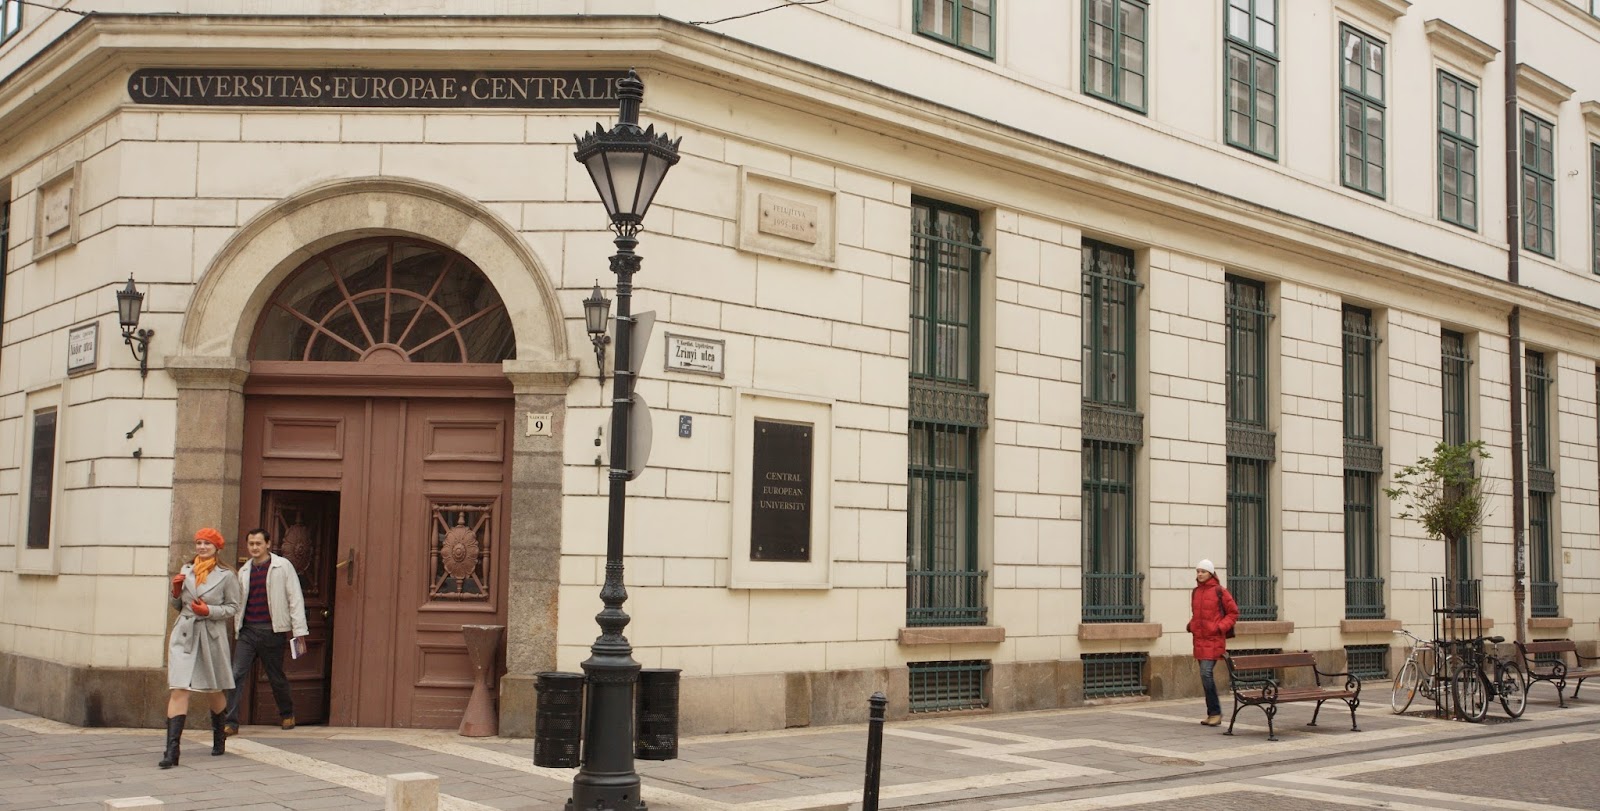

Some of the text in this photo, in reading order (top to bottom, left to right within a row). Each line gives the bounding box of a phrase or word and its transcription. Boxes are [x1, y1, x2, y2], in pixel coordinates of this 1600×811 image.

[140, 75, 322, 98] UNIVERSITAS
[332, 76, 457, 100] EUROPAE
[701, 350, 715, 361] utca
[535, 420, 543, 432] 9
[765, 471, 802, 482] CENTRAL
[763, 486, 804, 496] EUROPEAN
[760, 500, 806, 511] UNIVERSITY
